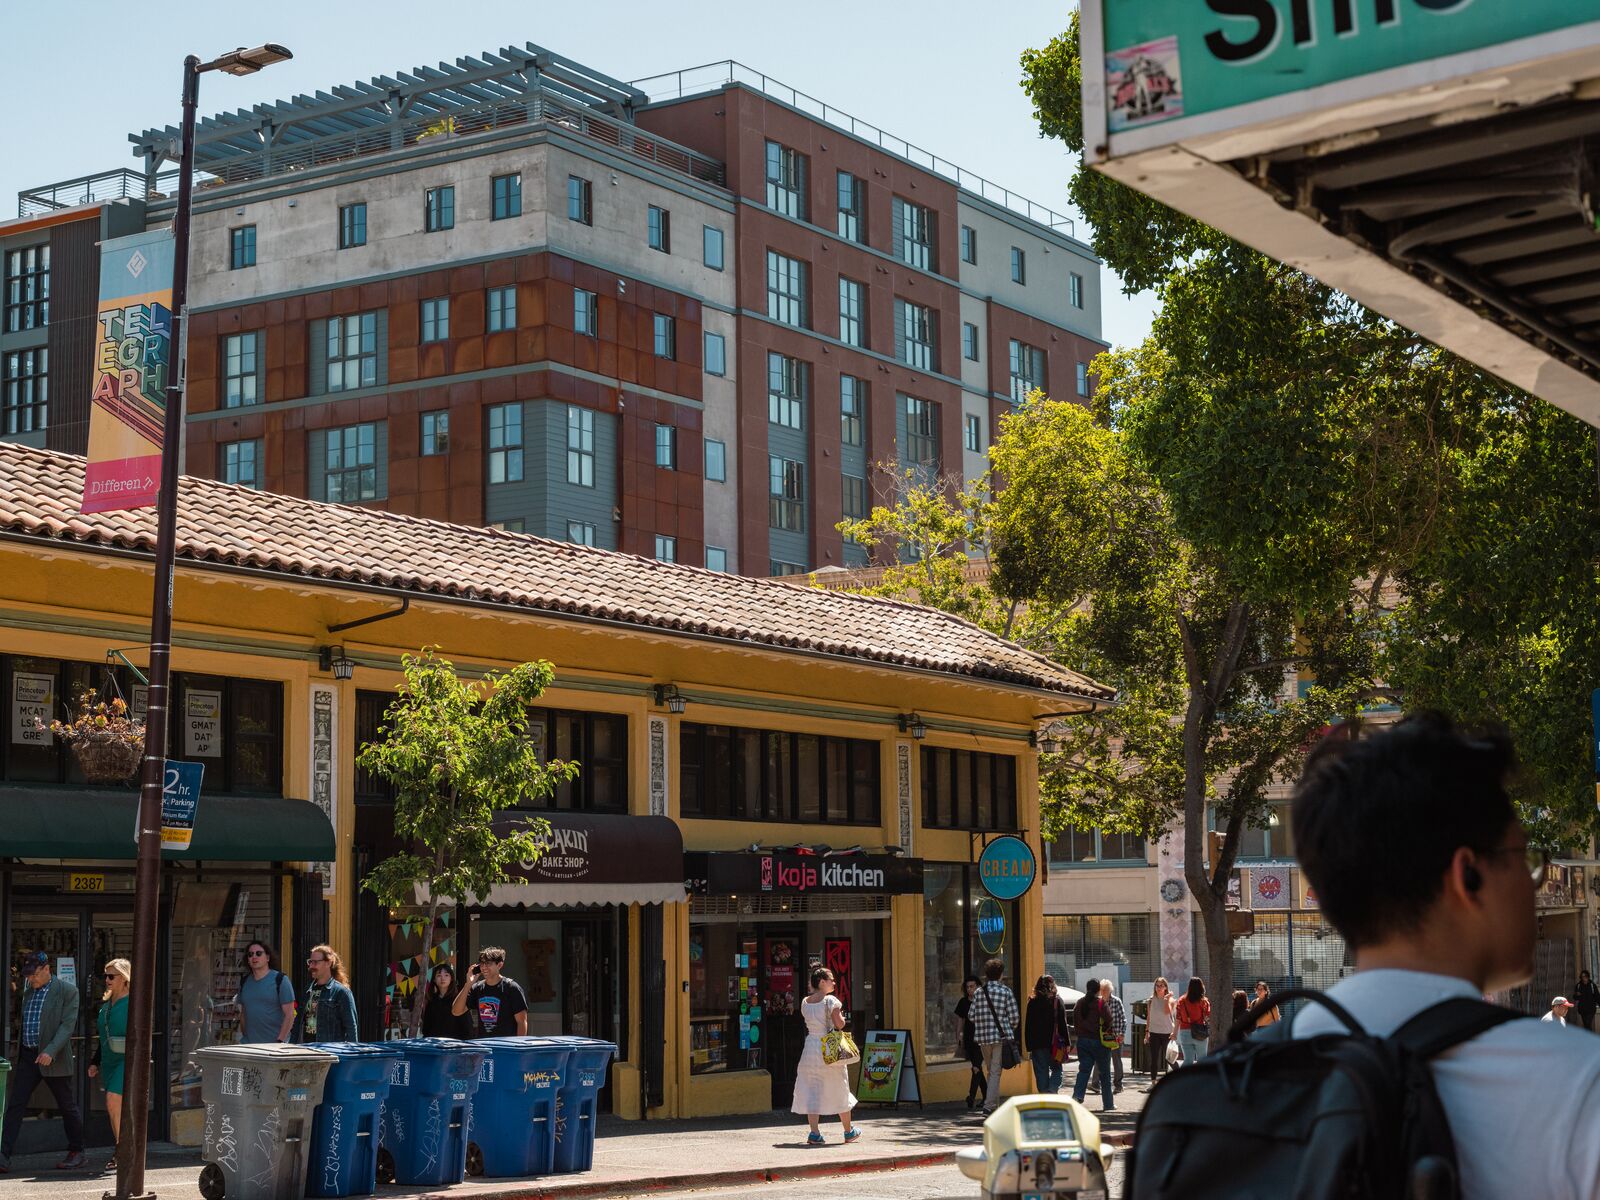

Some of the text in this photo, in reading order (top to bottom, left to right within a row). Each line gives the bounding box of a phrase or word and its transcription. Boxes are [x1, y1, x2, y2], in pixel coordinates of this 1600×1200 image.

[19, 686, 46, 694] Princeton
[170, 799, 194, 808] Parking
[542, 857, 584, 868] BAKE SHOP
[983, 859, 1031, 877] CREAM
[777, 861, 884, 890] koja kitchen
[74, 877, 102, 890] 2387
[979, 916, 1004, 934] CREAM
